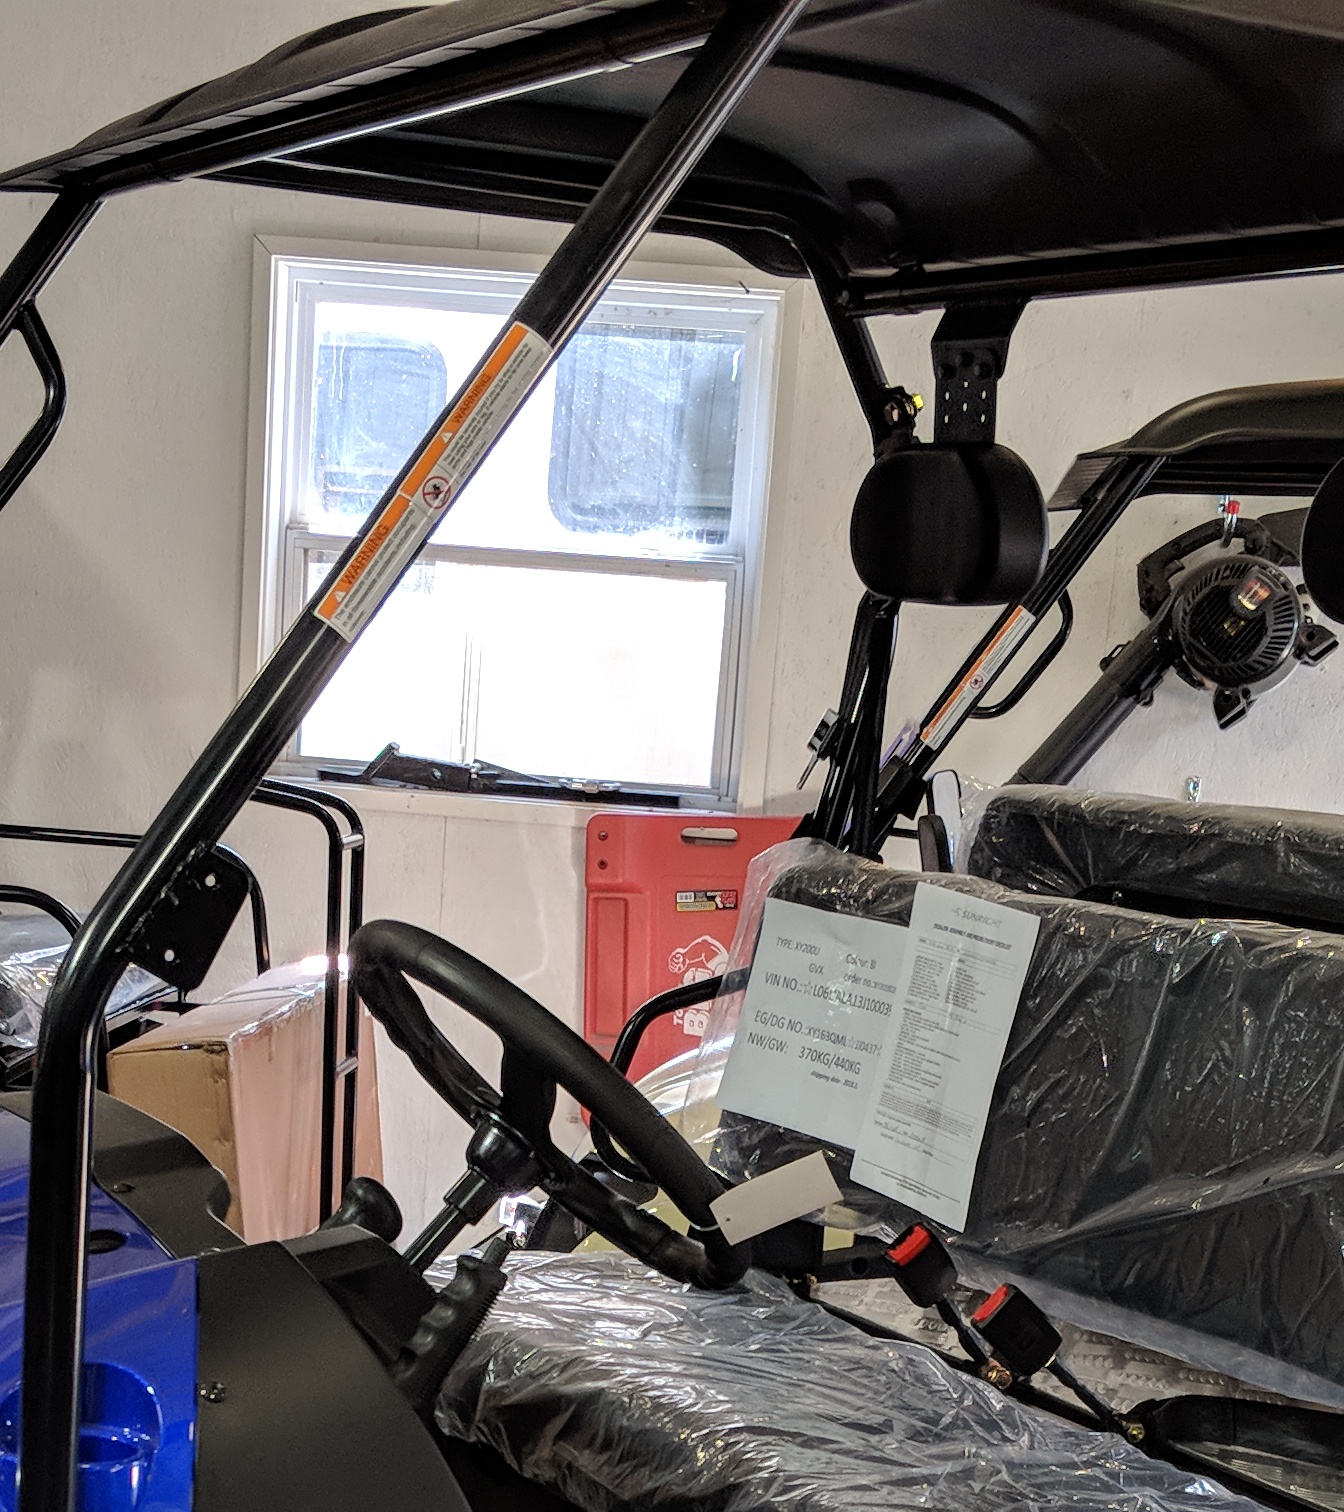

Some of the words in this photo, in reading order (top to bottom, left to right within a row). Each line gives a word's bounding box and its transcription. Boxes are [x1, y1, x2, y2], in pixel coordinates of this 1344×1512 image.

[452, 372, 492, 425] WARNING
[341, 522, 390, 586] WARNING
[763, 971, 781, 986] VIN
[753, 1009, 786, 1030] EG/DG
